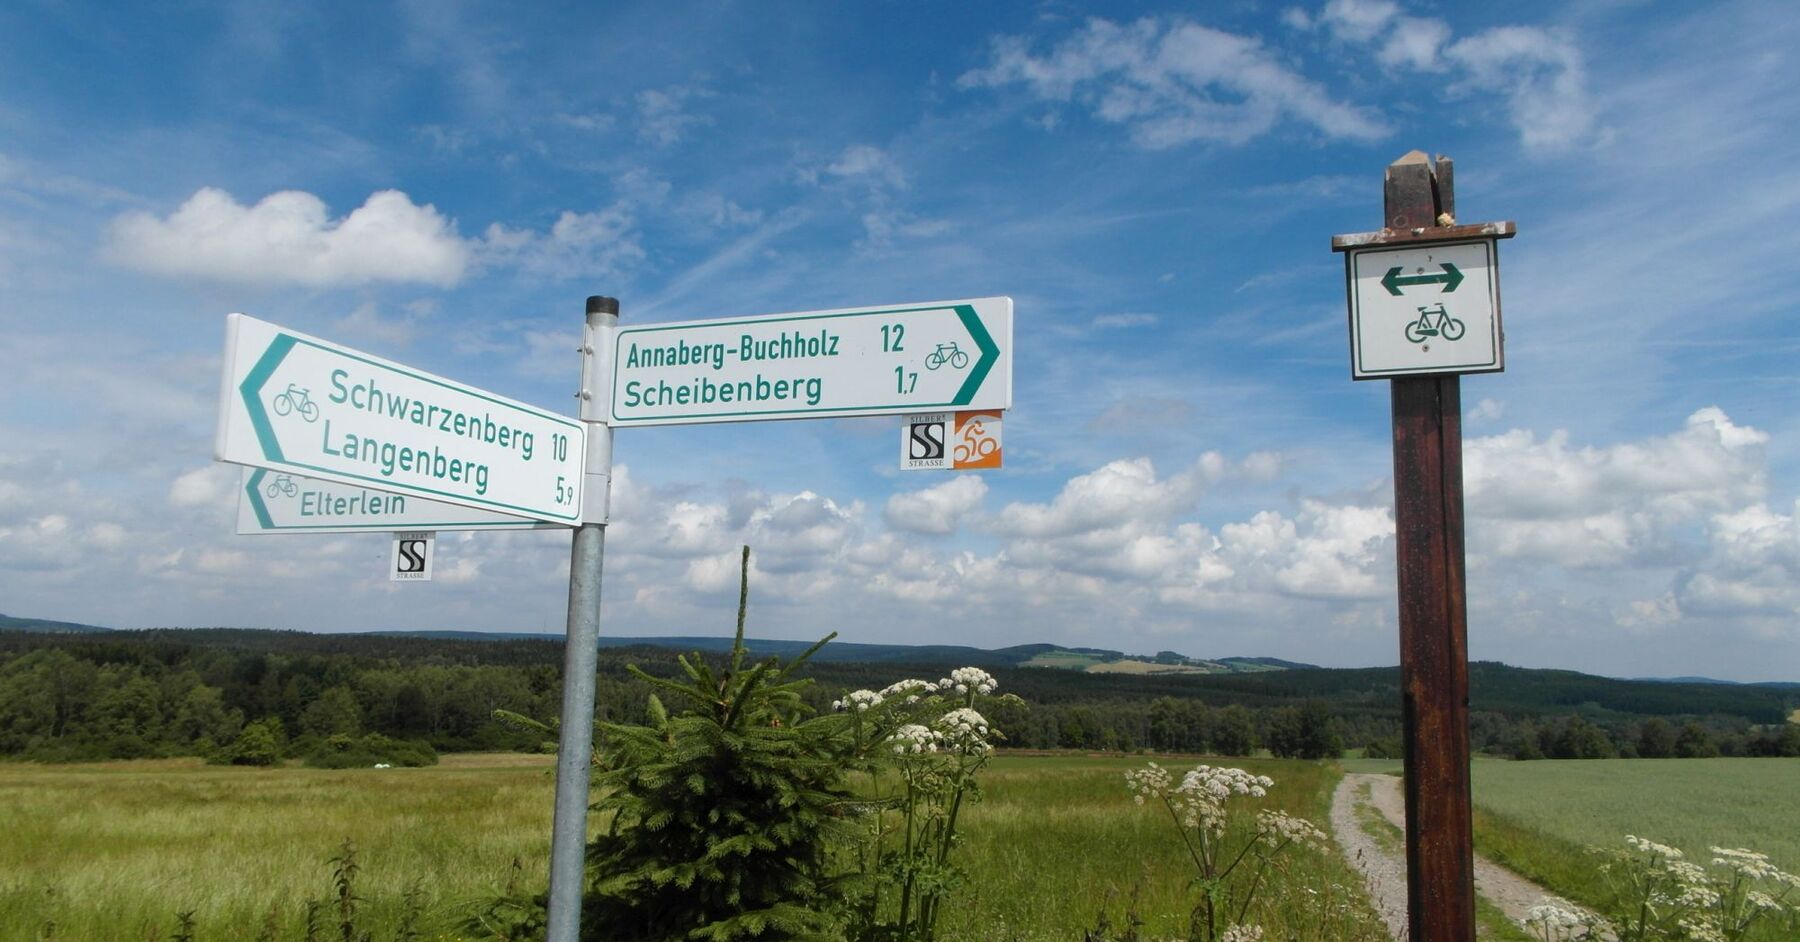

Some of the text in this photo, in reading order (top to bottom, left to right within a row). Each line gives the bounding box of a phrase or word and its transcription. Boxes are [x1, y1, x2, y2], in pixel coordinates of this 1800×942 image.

[626, 324, 905, 370] Annaberg-Buchholz 12
[624, 374, 822, 406] Scheibenberg
[328, 369, 567, 462] Schwarzenberg 10
[322, 419, 489, 496] Langenberg
[909, 459, 944, 467] STRASSE
[300, 491, 405, 517] Elterlein
